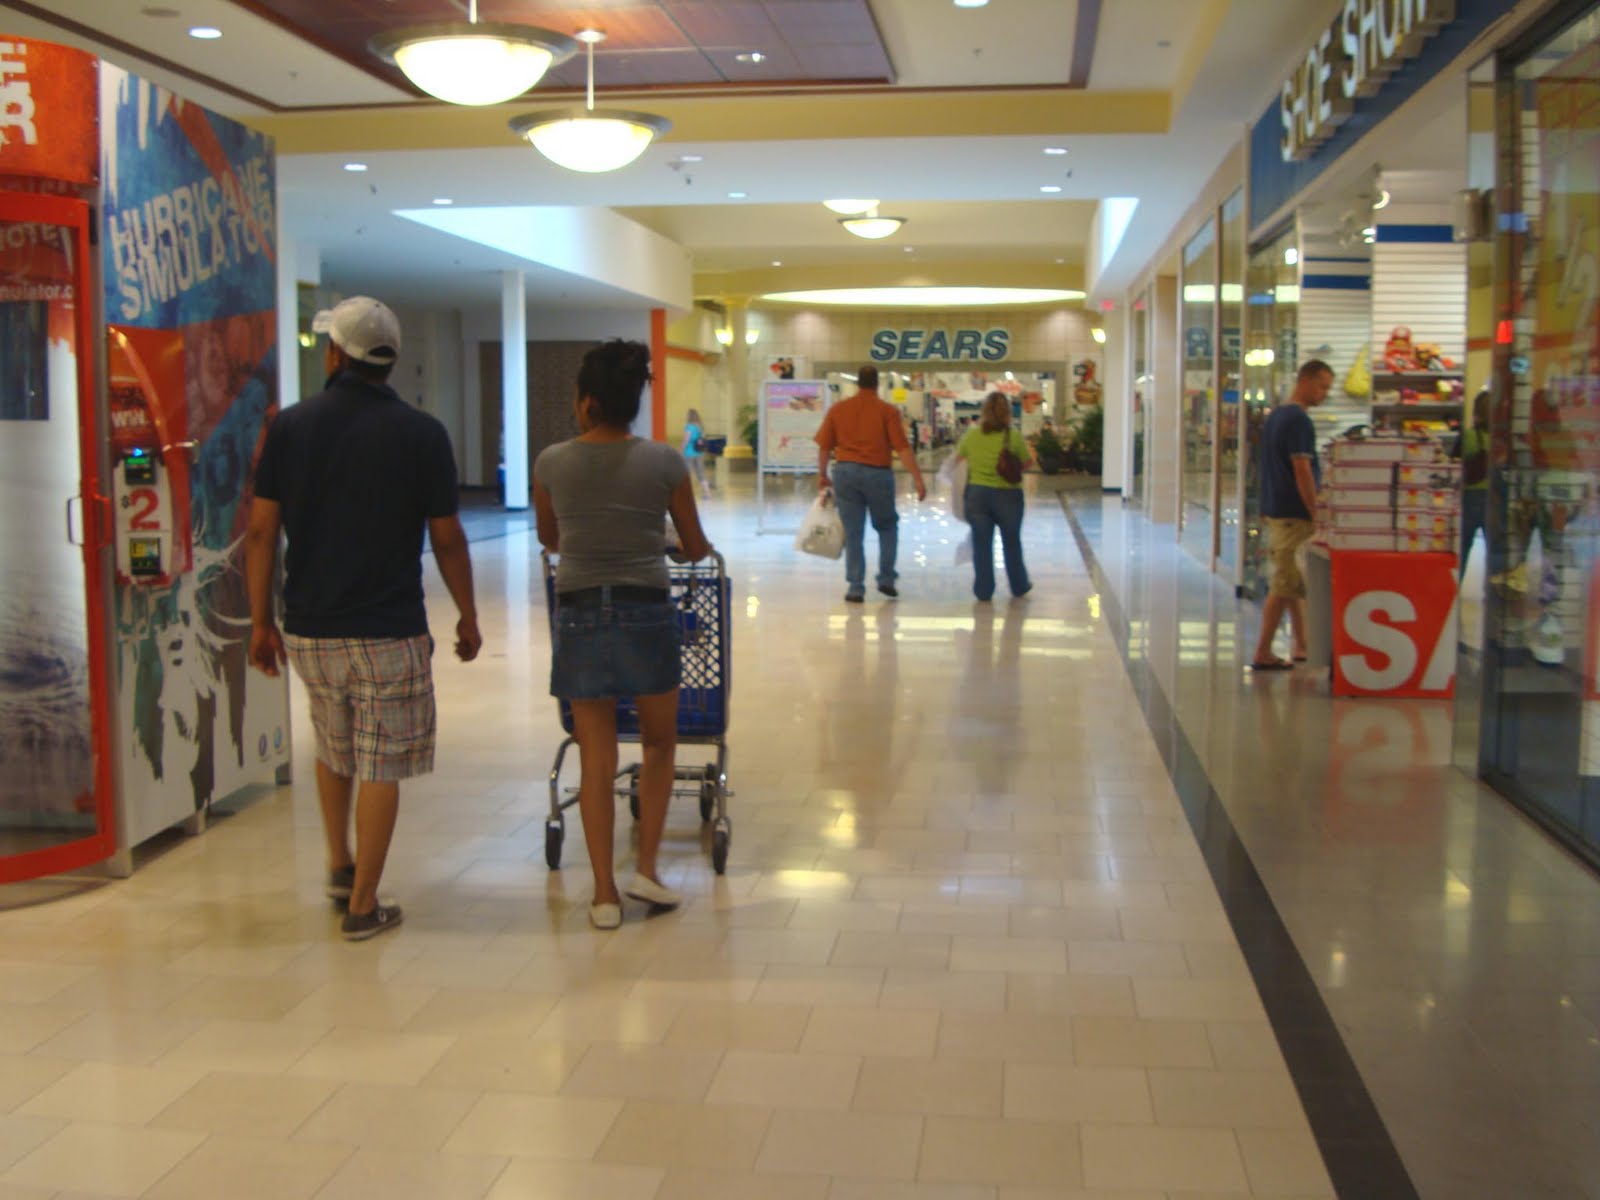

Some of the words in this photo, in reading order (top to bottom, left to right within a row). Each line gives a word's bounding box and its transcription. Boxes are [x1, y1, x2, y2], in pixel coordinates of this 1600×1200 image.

[1281, 27, 1332, 163] SHOE
[108, 157, 269, 273] HURRICANE
[119, 190, 275, 321] SIMULATOR
[869, 327, 1010, 361] SEARS
